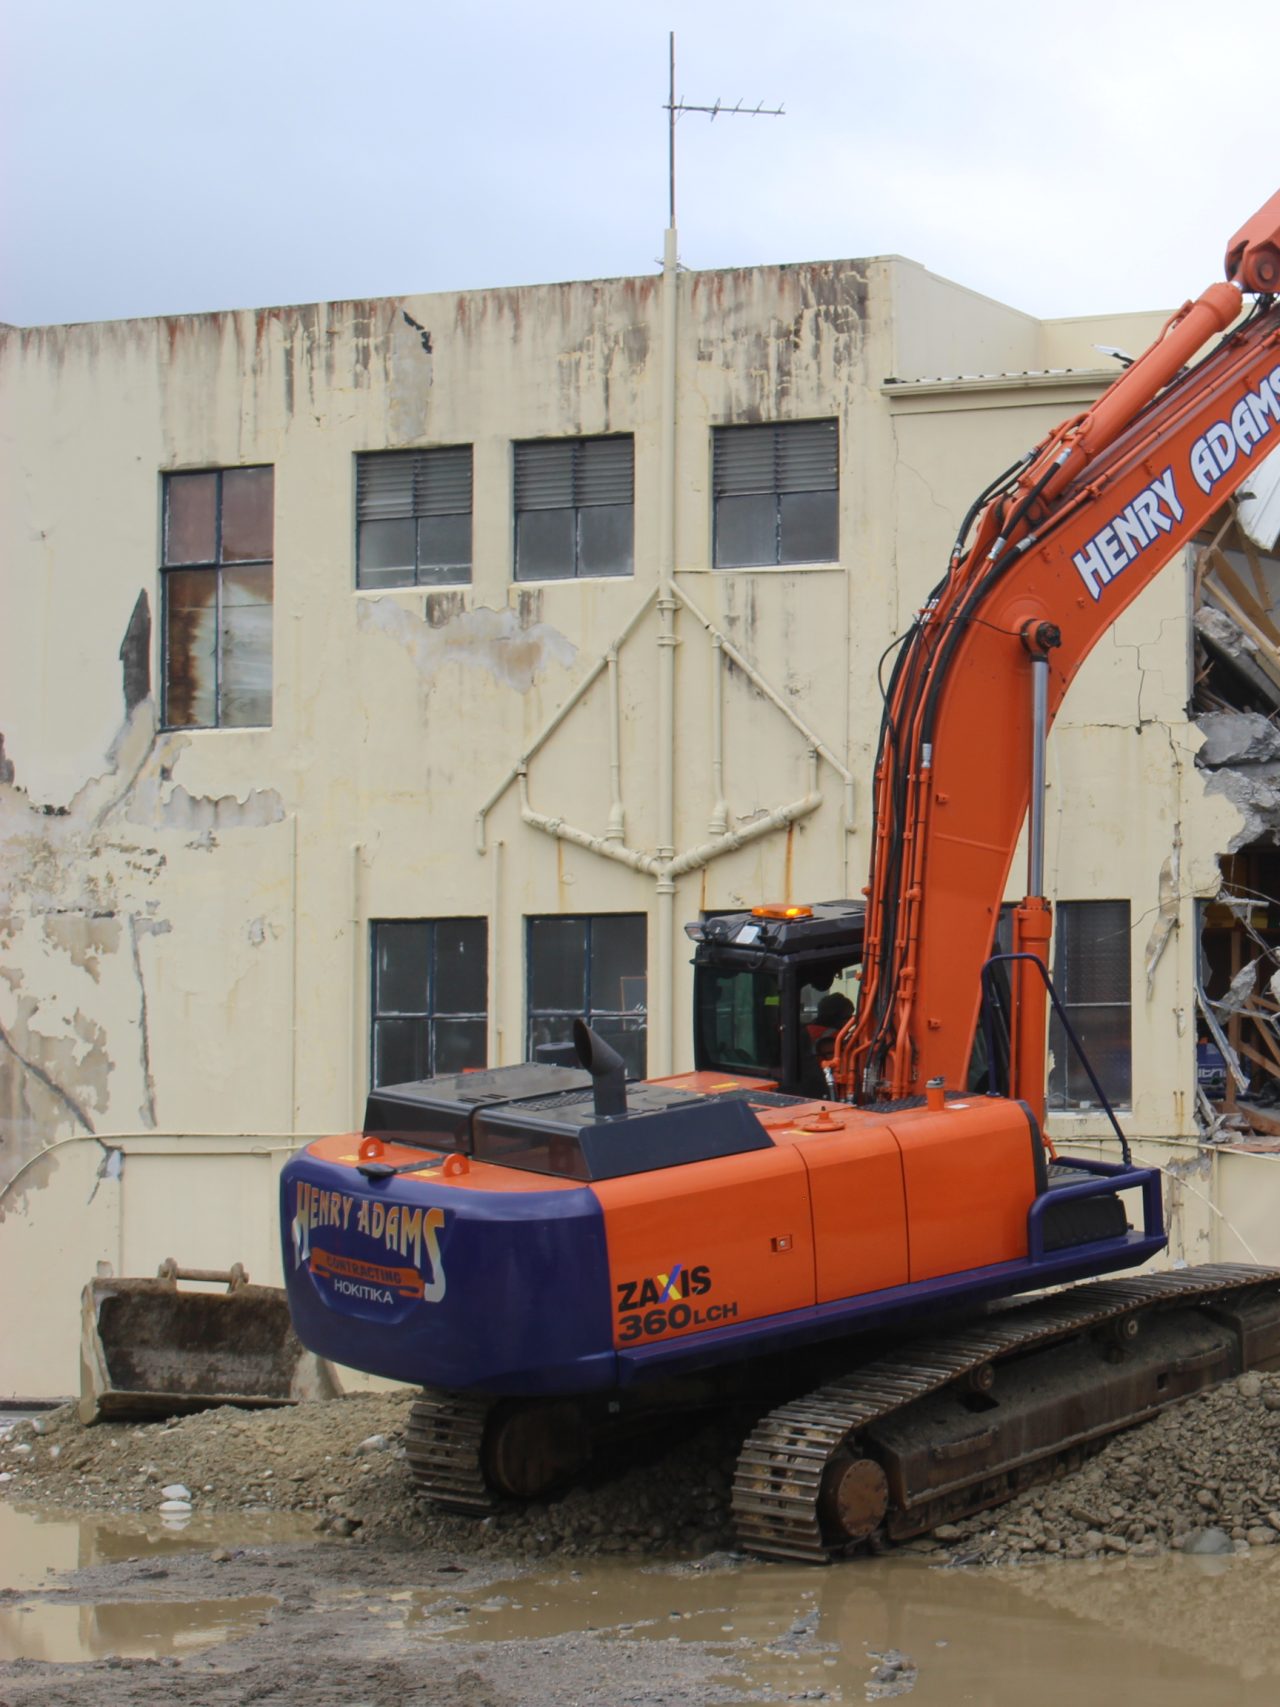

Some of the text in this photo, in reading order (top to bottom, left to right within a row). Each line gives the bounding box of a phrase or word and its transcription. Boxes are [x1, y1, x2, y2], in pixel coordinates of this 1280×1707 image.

[1071, 466, 1184, 602] HENRY
[291, 1181, 446, 1303] HENRY ADAMS
[334, 1278, 394, 1304] HOKITIKA
[617, 1263, 711, 1313] ZAXIS
